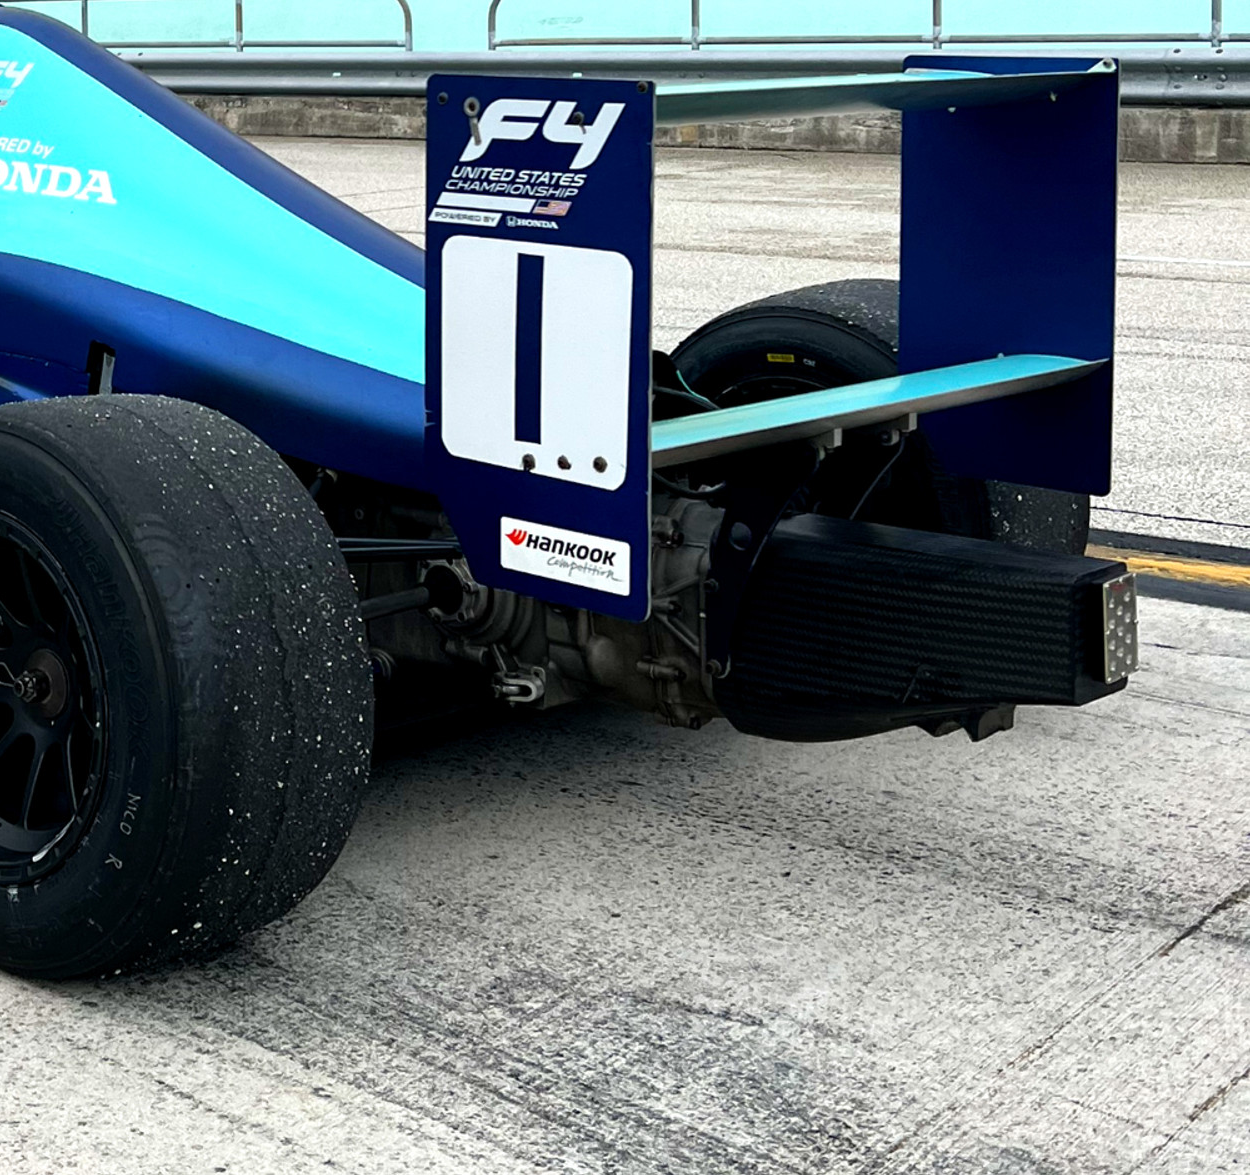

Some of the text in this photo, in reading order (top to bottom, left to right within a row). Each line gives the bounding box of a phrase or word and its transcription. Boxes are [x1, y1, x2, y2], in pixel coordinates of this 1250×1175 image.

[459, 98, 626, 169] F4
[32, 140, 54, 159] by
[451, 165, 587, 187] UNITED STATES
[445, 179, 579, 198] CHAMPIONSHIP
[435, 211, 496, 223] POWERED BY
[517, 218, 559, 229] HONDA
